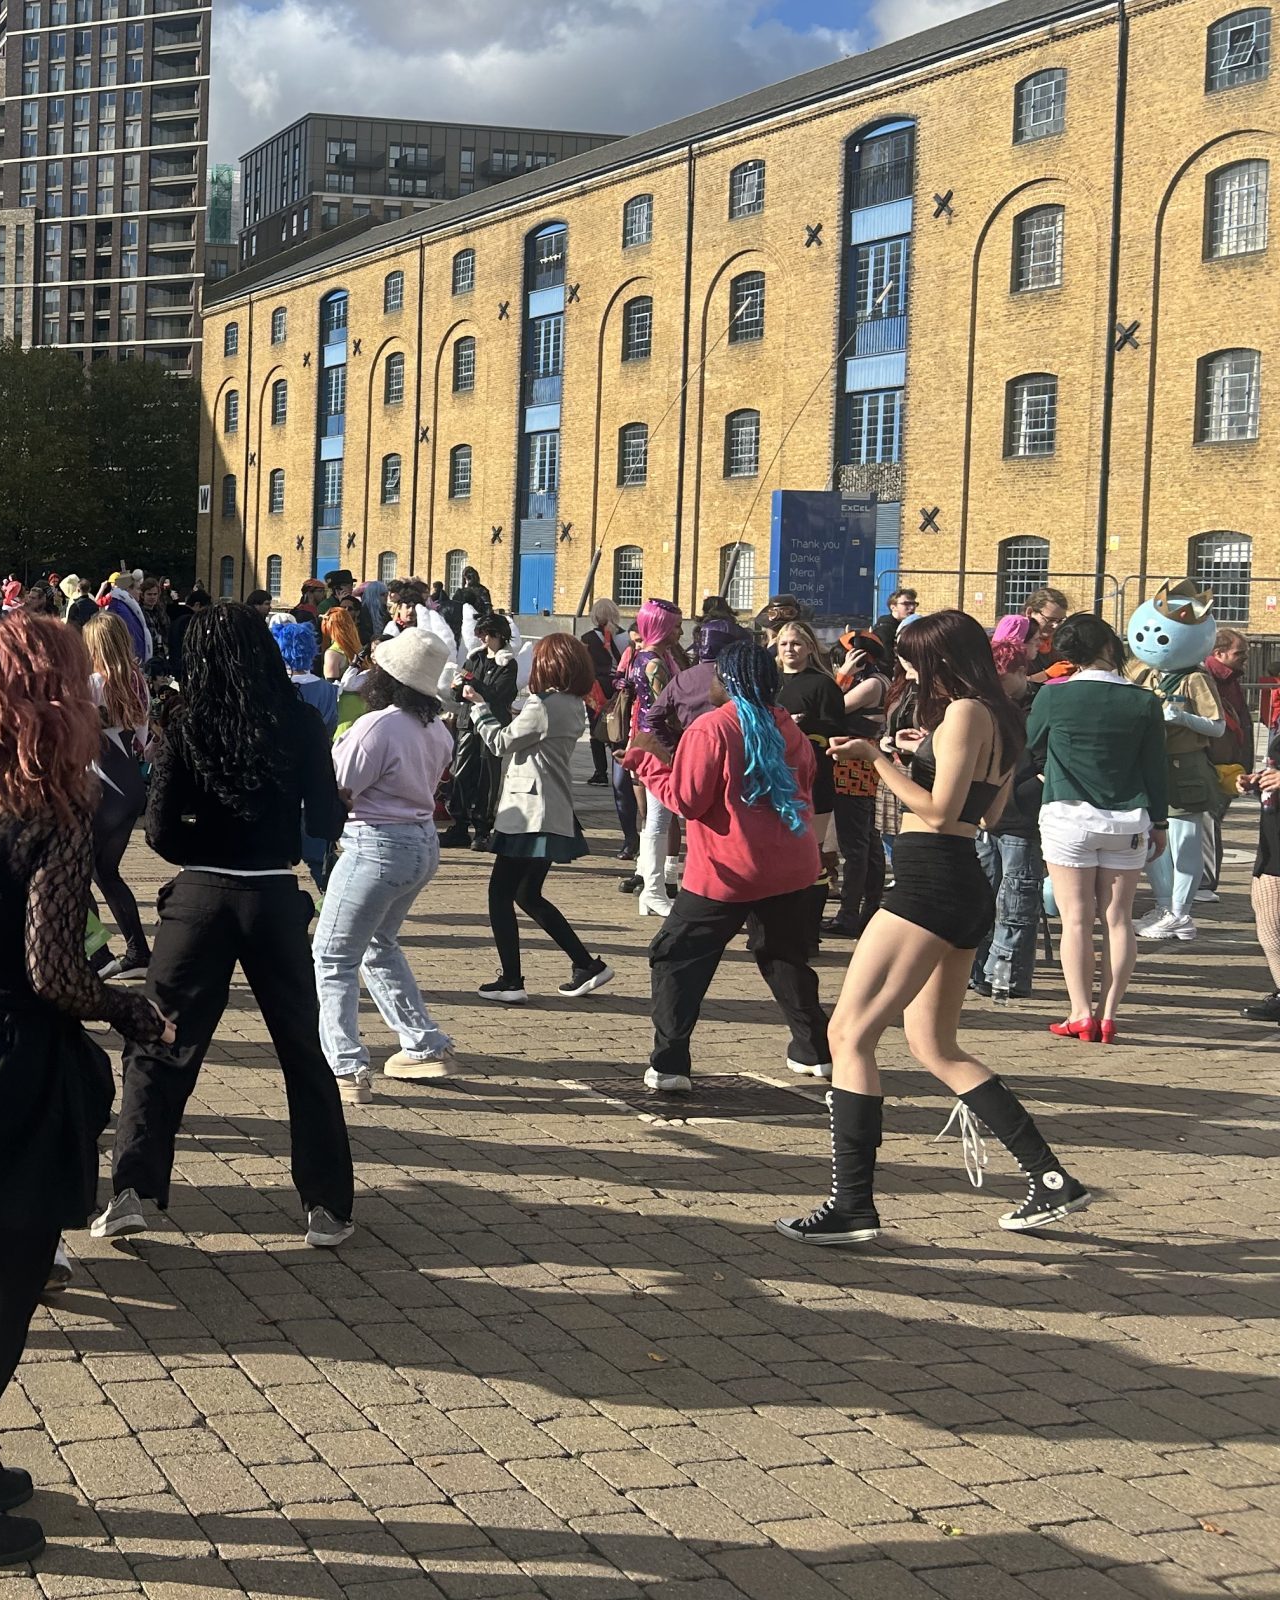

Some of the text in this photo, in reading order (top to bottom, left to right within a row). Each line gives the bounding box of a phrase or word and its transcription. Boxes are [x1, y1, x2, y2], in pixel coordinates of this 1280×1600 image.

[200, 487, 210, 511] W
[791, 538, 840, 551] Thank you
[790, 553, 820, 563] Danke
[789, 567, 815, 578] Merci
[789, 581, 825, 593] Dank je
[795, 597, 824, 606] racias
